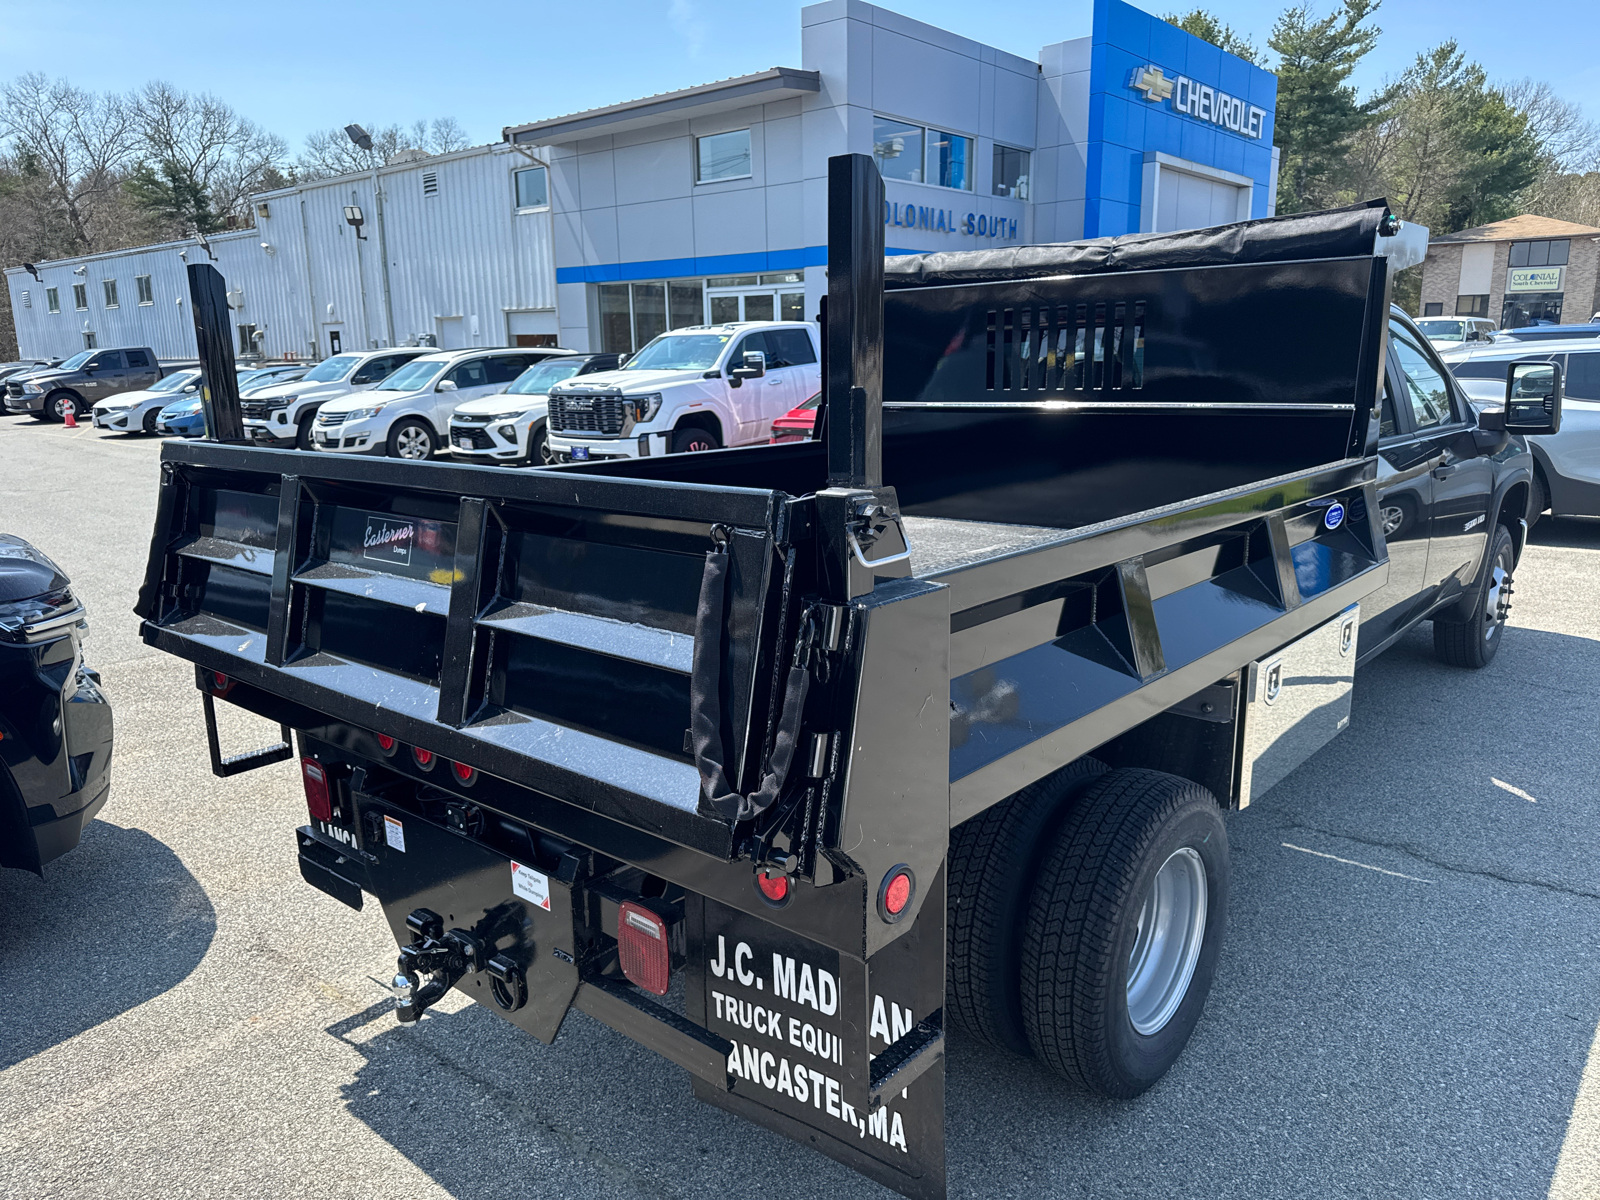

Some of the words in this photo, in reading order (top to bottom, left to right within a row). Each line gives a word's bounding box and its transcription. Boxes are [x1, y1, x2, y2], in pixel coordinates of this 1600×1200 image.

[1176, 76, 1266, 139] CHEVROLET
[885, 200, 956, 232] OLONIAL
[967, 213, 1017, 239] SOUTH
[1512, 273, 1557, 281] COLONIAL
[364, 522, 414, 548] Easterner
[393, 545, 407, 555] Dumps
[518, 869, 527, 878] Keep
[528, 887, 544, 900] Dumping
[710, 935, 763, 991] J.C.
[712, 991, 783, 1041] TRUCK
